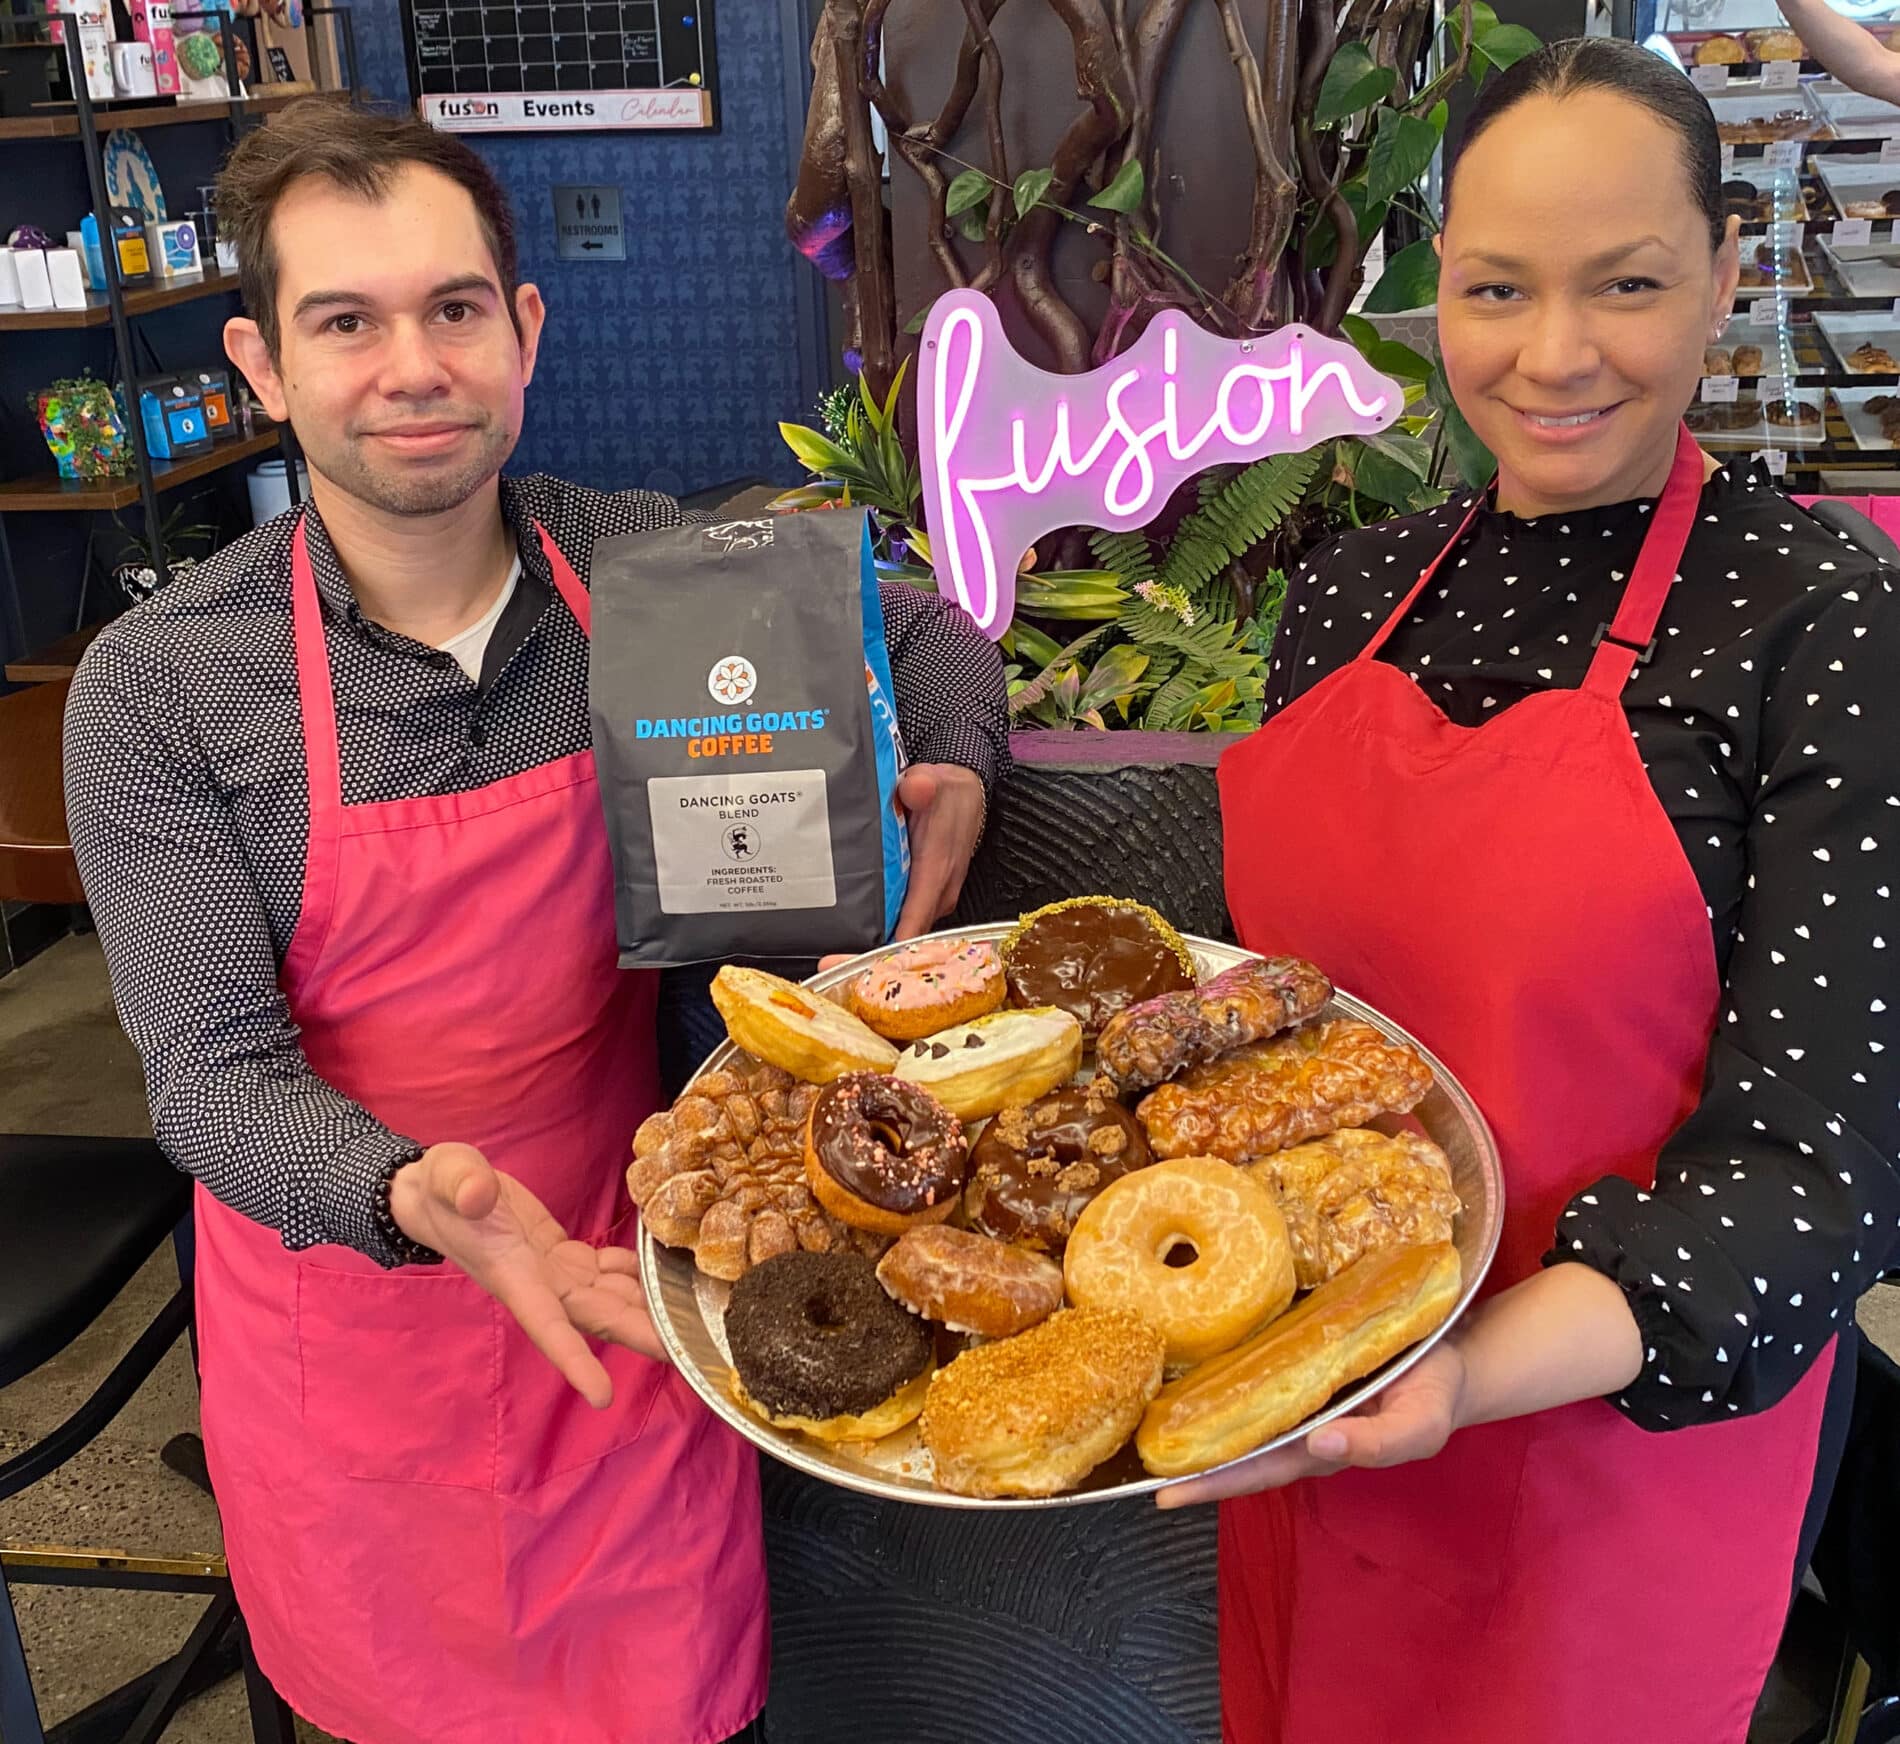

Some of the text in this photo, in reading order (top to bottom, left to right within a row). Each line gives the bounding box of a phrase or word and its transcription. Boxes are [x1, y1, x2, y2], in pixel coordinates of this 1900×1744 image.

[523, 99, 595, 117] Events
[621, 96, 696, 121] Calendar
[561, 225, 619, 235] RESTROOMS
[934, 307, 1387, 630] fusion
[635, 714, 743, 739] DANCING
[687, 734, 774, 758] COFFEE
[680, 796, 744, 808] DANCING
[719, 809, 759, 819] BLEND
[711, 866, 776, 876] INGREDIENTS:
[707, 875, 783, 886] FRESH ROASTED
[727, 885, 765, 895] COFFEE
